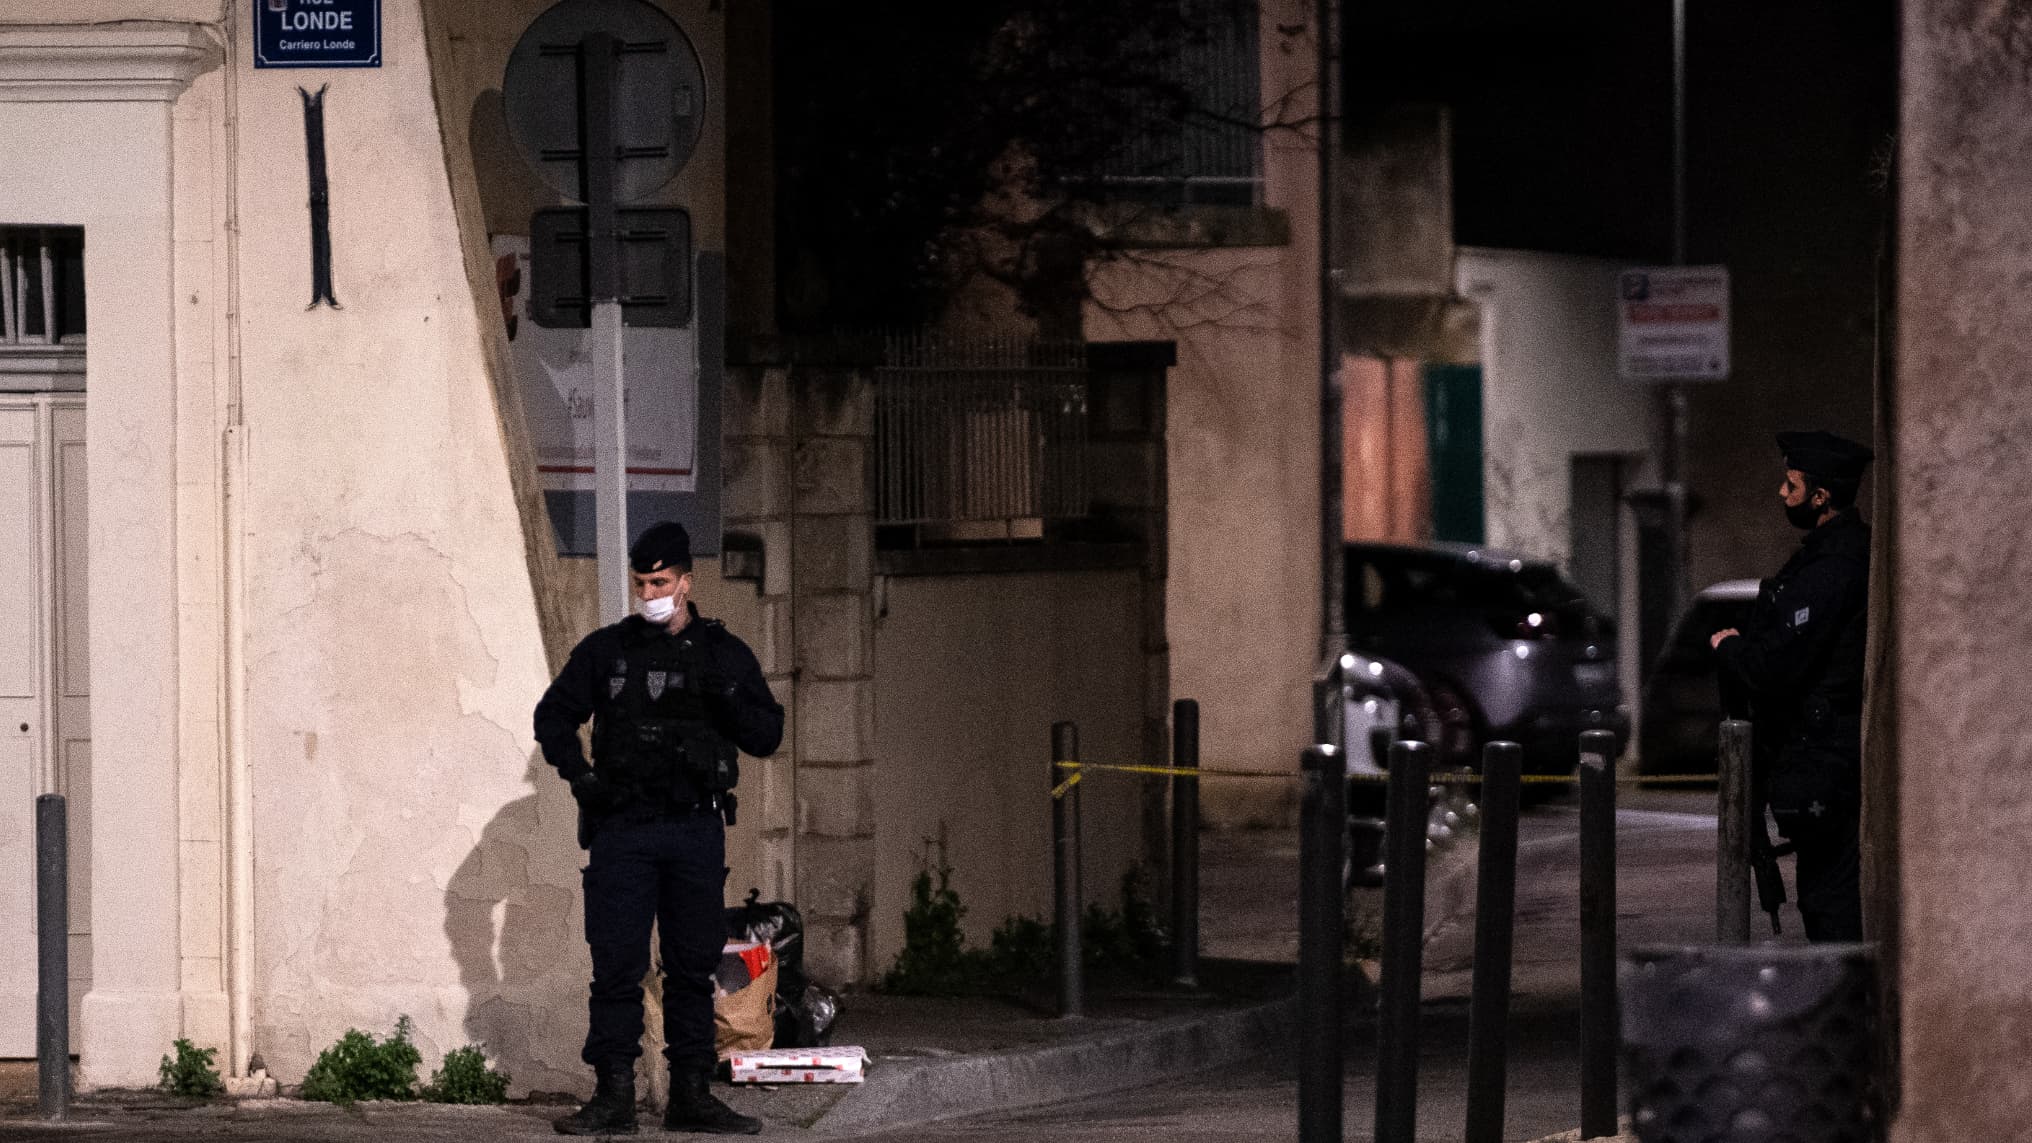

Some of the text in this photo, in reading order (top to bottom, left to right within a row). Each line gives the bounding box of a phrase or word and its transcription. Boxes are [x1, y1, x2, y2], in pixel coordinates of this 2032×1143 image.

[281, 11, 353, 30] LONDE
[280, 40, 356, 50] Carriero Londe
